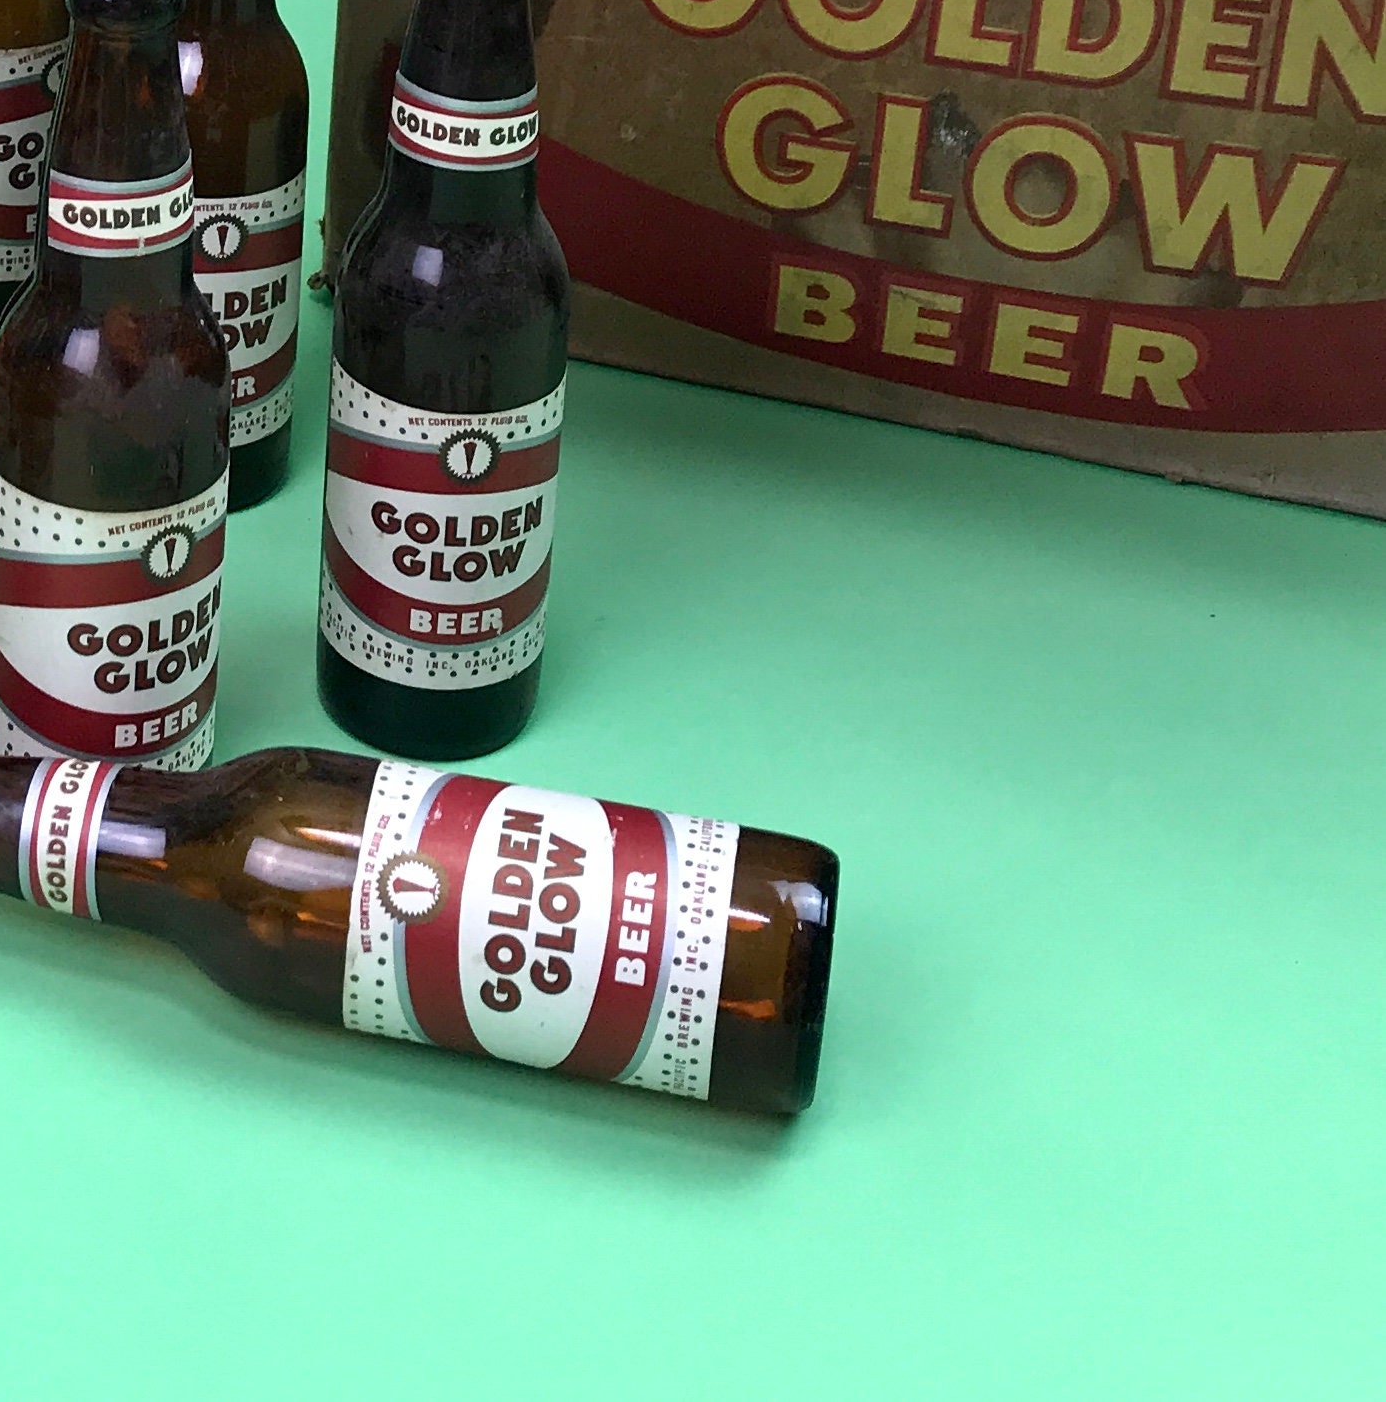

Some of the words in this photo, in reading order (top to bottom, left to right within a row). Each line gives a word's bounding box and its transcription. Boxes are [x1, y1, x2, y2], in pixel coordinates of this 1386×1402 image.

[397, 105, 480, 147] GOLDEN
[715, 74, 1348, 290] GLOW
[63, 203, 162, 230] GOLDEN
[772, 263, 1210, 412] BEER
[408, 416, 425, 426] NET
[428, 416, 473, 427] CONTENTS
[107, 524, 125, 536] NET
[129, 513, 172, 532] CONTENTS
[371, 495, 544, 547] GOLDEN
[392, 539, 527, 582] GLOW
[67, 576, 221, 657] GOLDEN
[409, 607, 503, 636] BEER
[93, 626, 212, 694] GLOW
[362, 641, 414, 666] BREWING
[114, 701, 198, 749] BEER
[46, 805, 73, 904] GOLDEN
[60, 758, 89, 795] GLO
[360, 879, 372, 931] CONTENTS
[480, 808, 544, 1013] GOLDEN
[530, 833, 587, 996] GLOW
[615, 870, 658, 988] BEER
[684, 938, 700, 972] INC.
[677, 986, 694, 1049] BREWING
